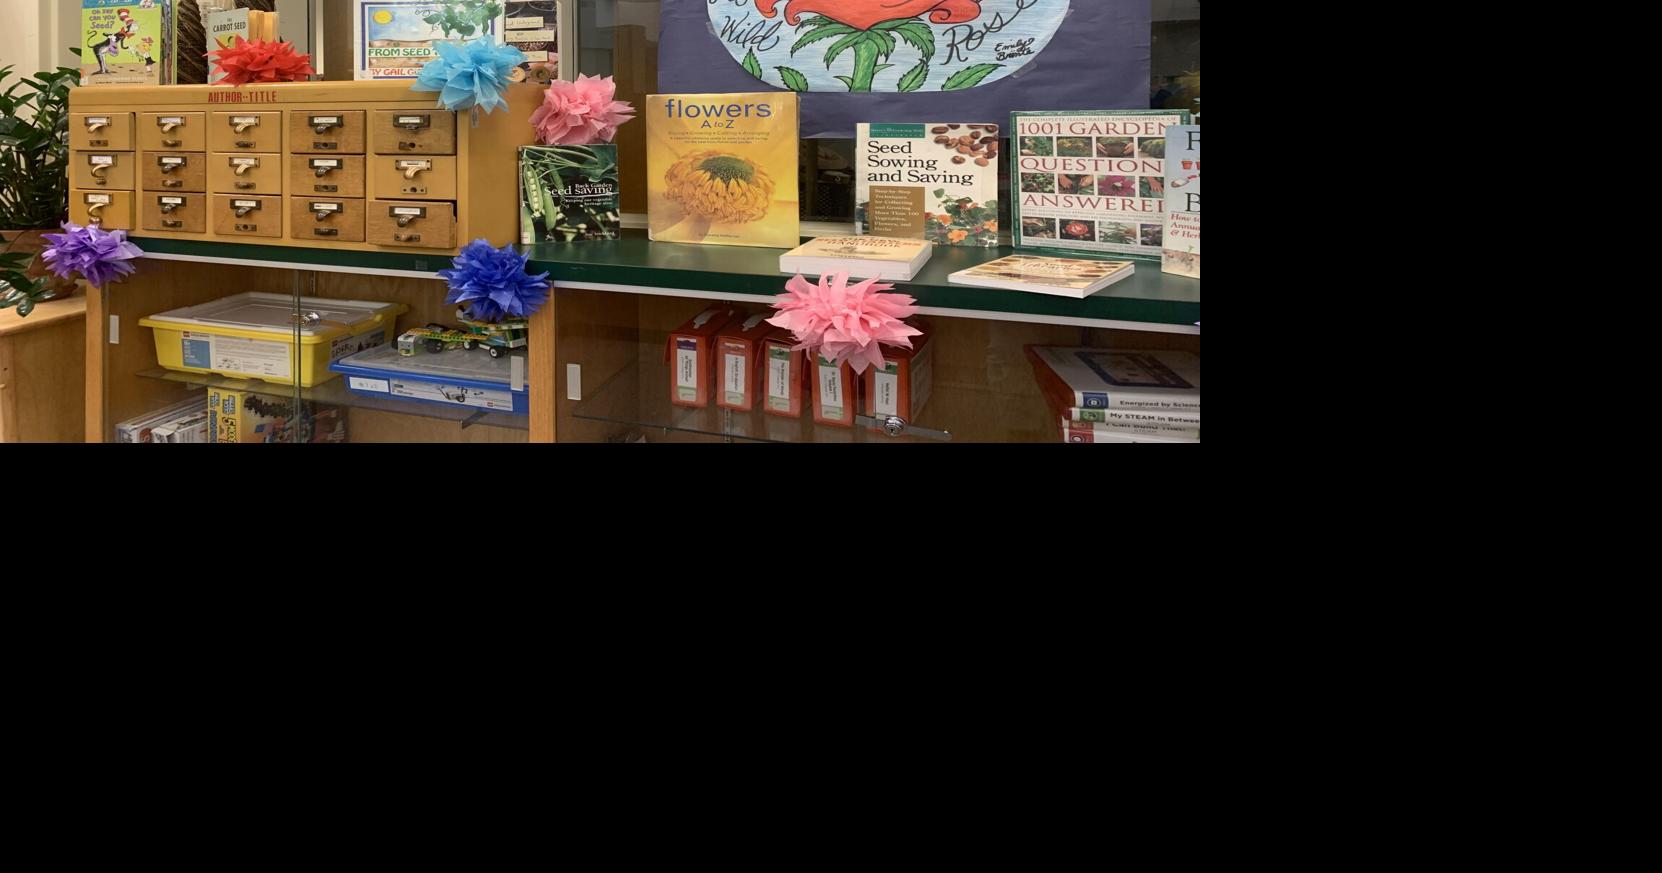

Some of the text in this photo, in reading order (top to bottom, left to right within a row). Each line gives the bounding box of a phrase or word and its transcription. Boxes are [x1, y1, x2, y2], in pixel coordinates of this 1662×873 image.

[213, 21, 247, 32] CARROT SEED
[720, 11, 783, 51] Wild
[368, 48, 400, 56] FROM
[402, 48, 431, 56] SEED
[383, 68, 406, 76] GAIL
[665, 98, 772, 118] flowers
[701, 120, 712, 129] A
[725, 120, 735, 129] Z
[1019, 122, 1062, 135] 1001
[868, 140, 912, 154] Seed
[868, 155, 938, 171] Sowing
[867, 169, 974, 186] and Saving
[544, 185, 572, 196] Seed
[1170, 213, 1191, 221] How
[1120, 400, 1158, 409] Energized
[1160, 400, 1171, 409] by
[1125, 413, 1155, 421] STEAM
